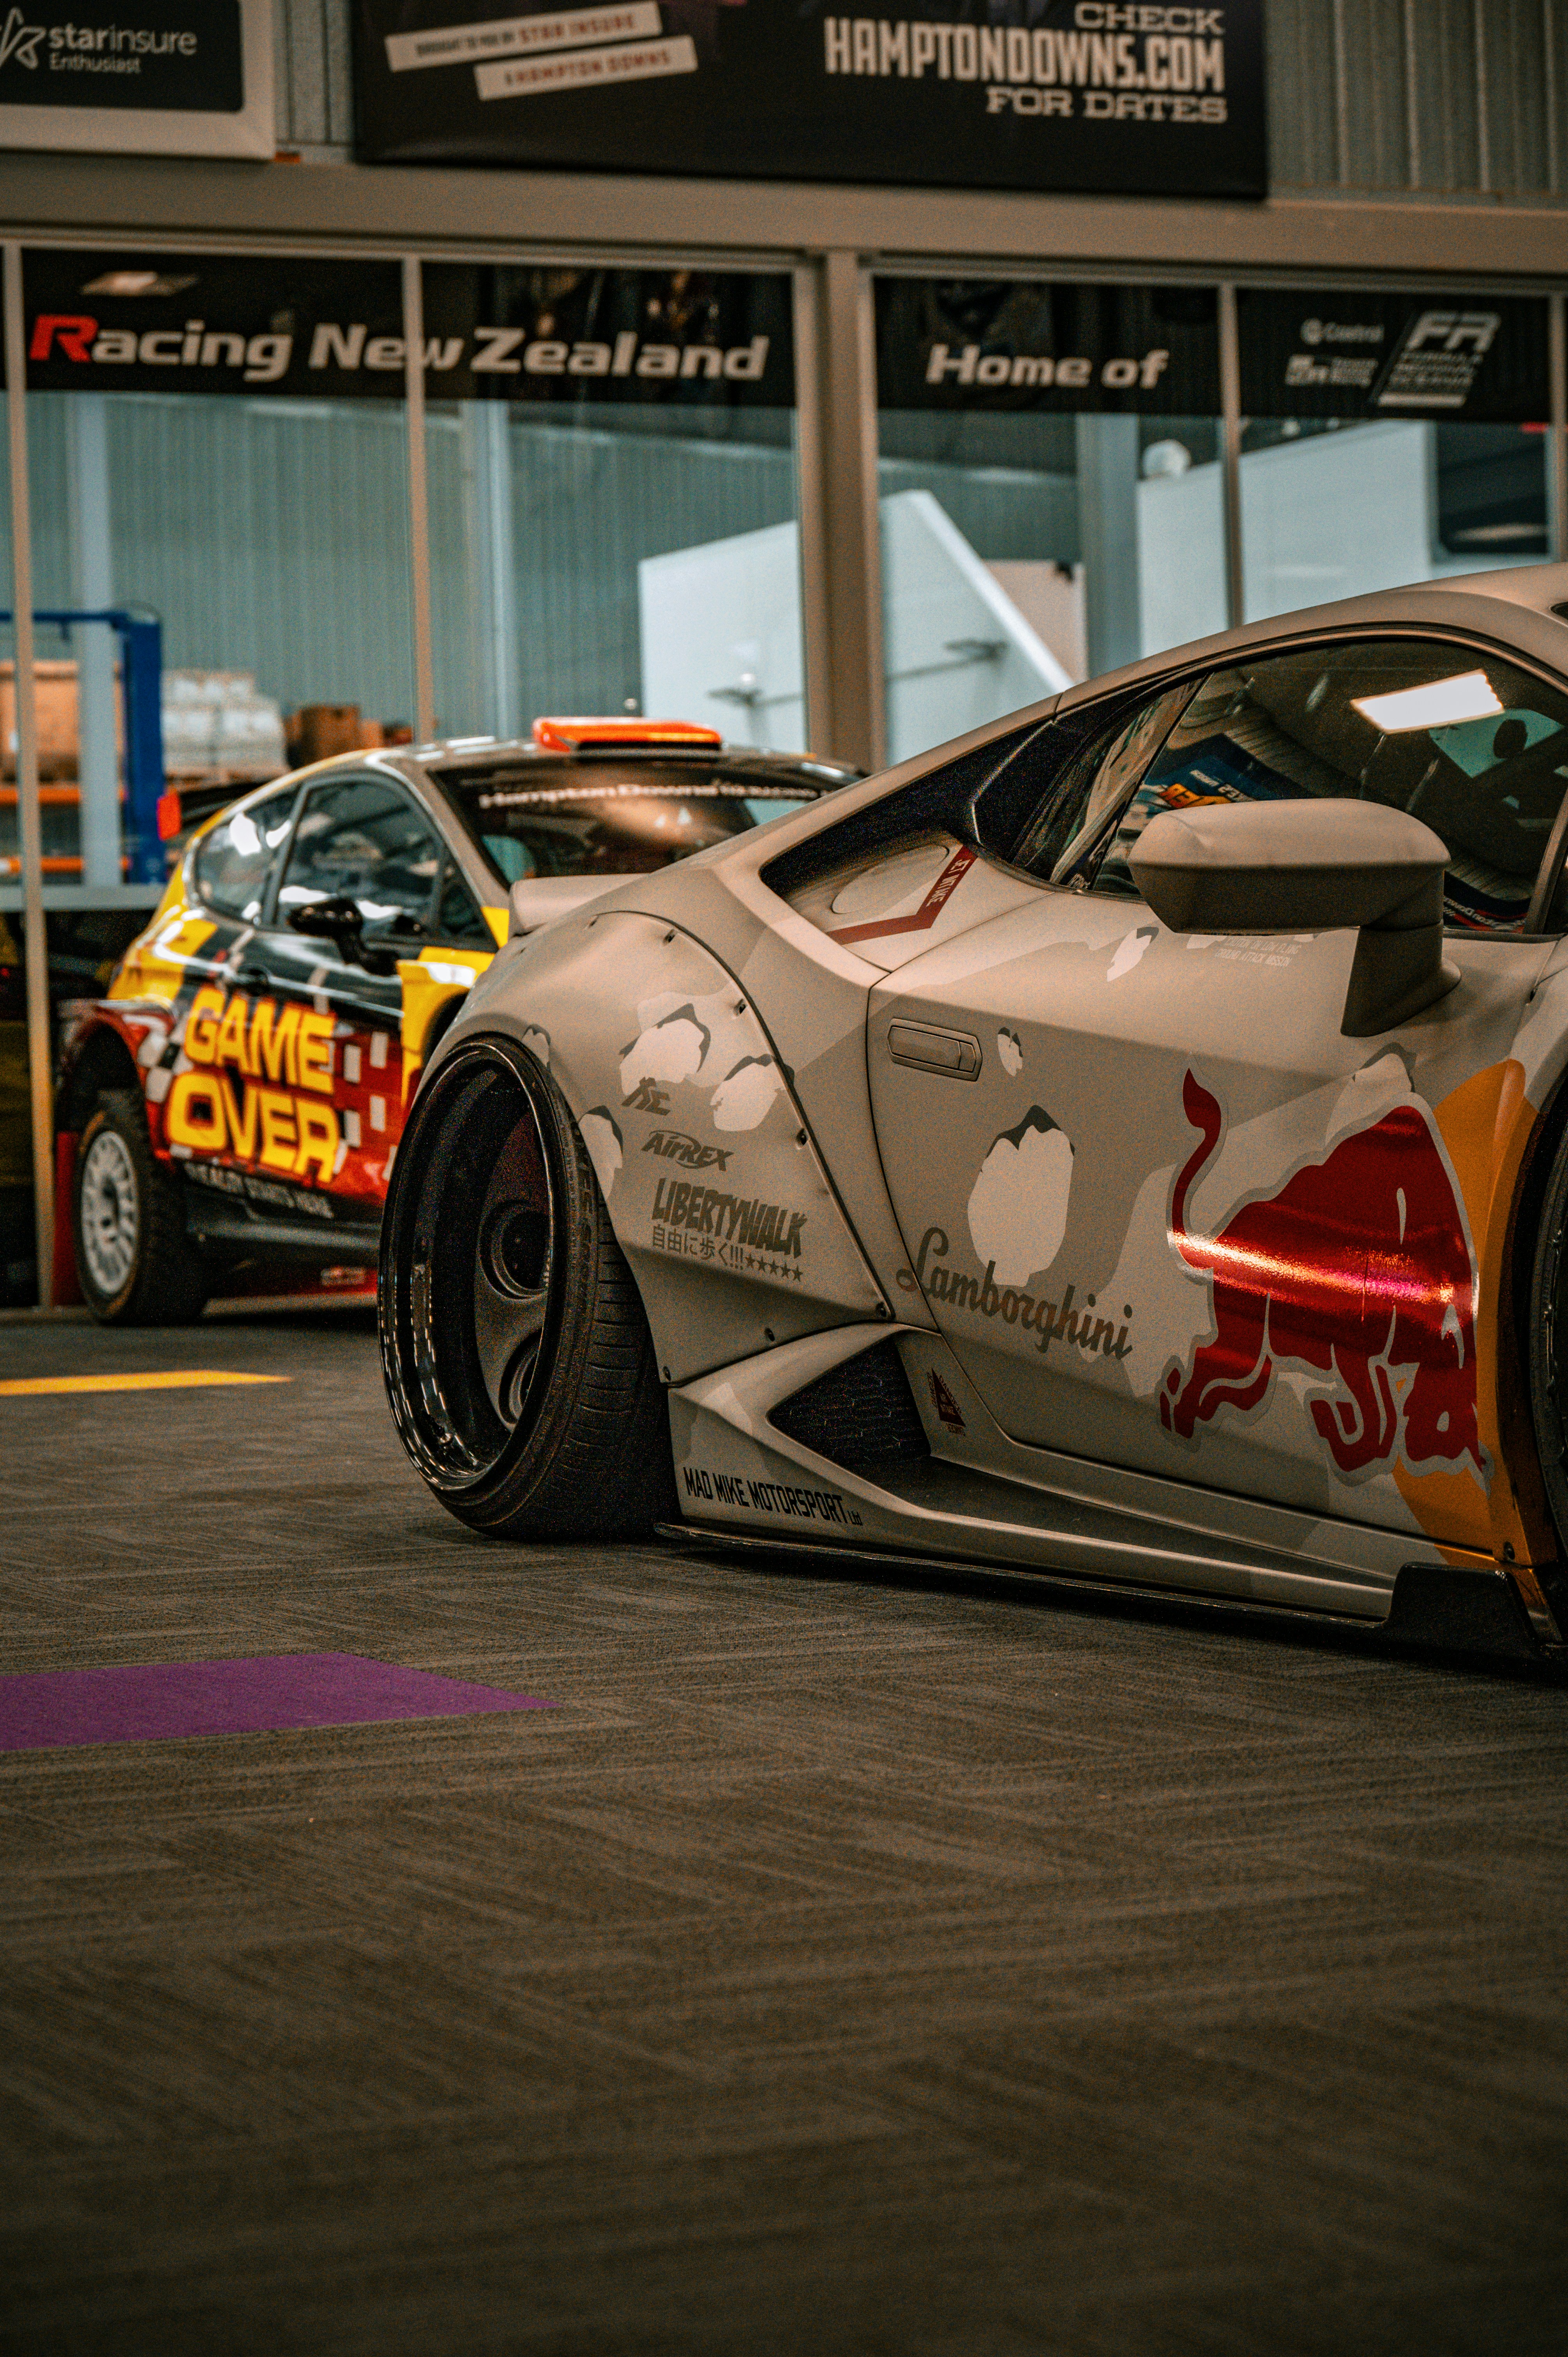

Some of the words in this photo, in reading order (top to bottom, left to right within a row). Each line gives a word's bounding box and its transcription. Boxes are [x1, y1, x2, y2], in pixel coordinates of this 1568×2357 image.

[1074, 2, 1226, 35] CHECK
[49, 52, 142, 74] Enthusiast
[824, 16, 1226, 92] HAMPTONDOWNS.COM
[986, 85, 1074, 117] FOR
[1083, 90, 1228, 124] DATES
[29, 314, 294, 383] Racing
[308, 322, 464, 370] New
[470, 327, 770, 381] Zealand
[925, 343, 1093, 388] Home
[1102, 349, 1170, 389] of
[184, 984, 337, 1095] GAME
[166, 1071, 340, 1184] OVER
[896, 1226, 1133, 1360] Lamborghini
[683, 1466, 713, 1500] MAD
[712, 1473, 750, 1507] MIKE
[747, 1480, 849, 1524] MOTORSPORT
